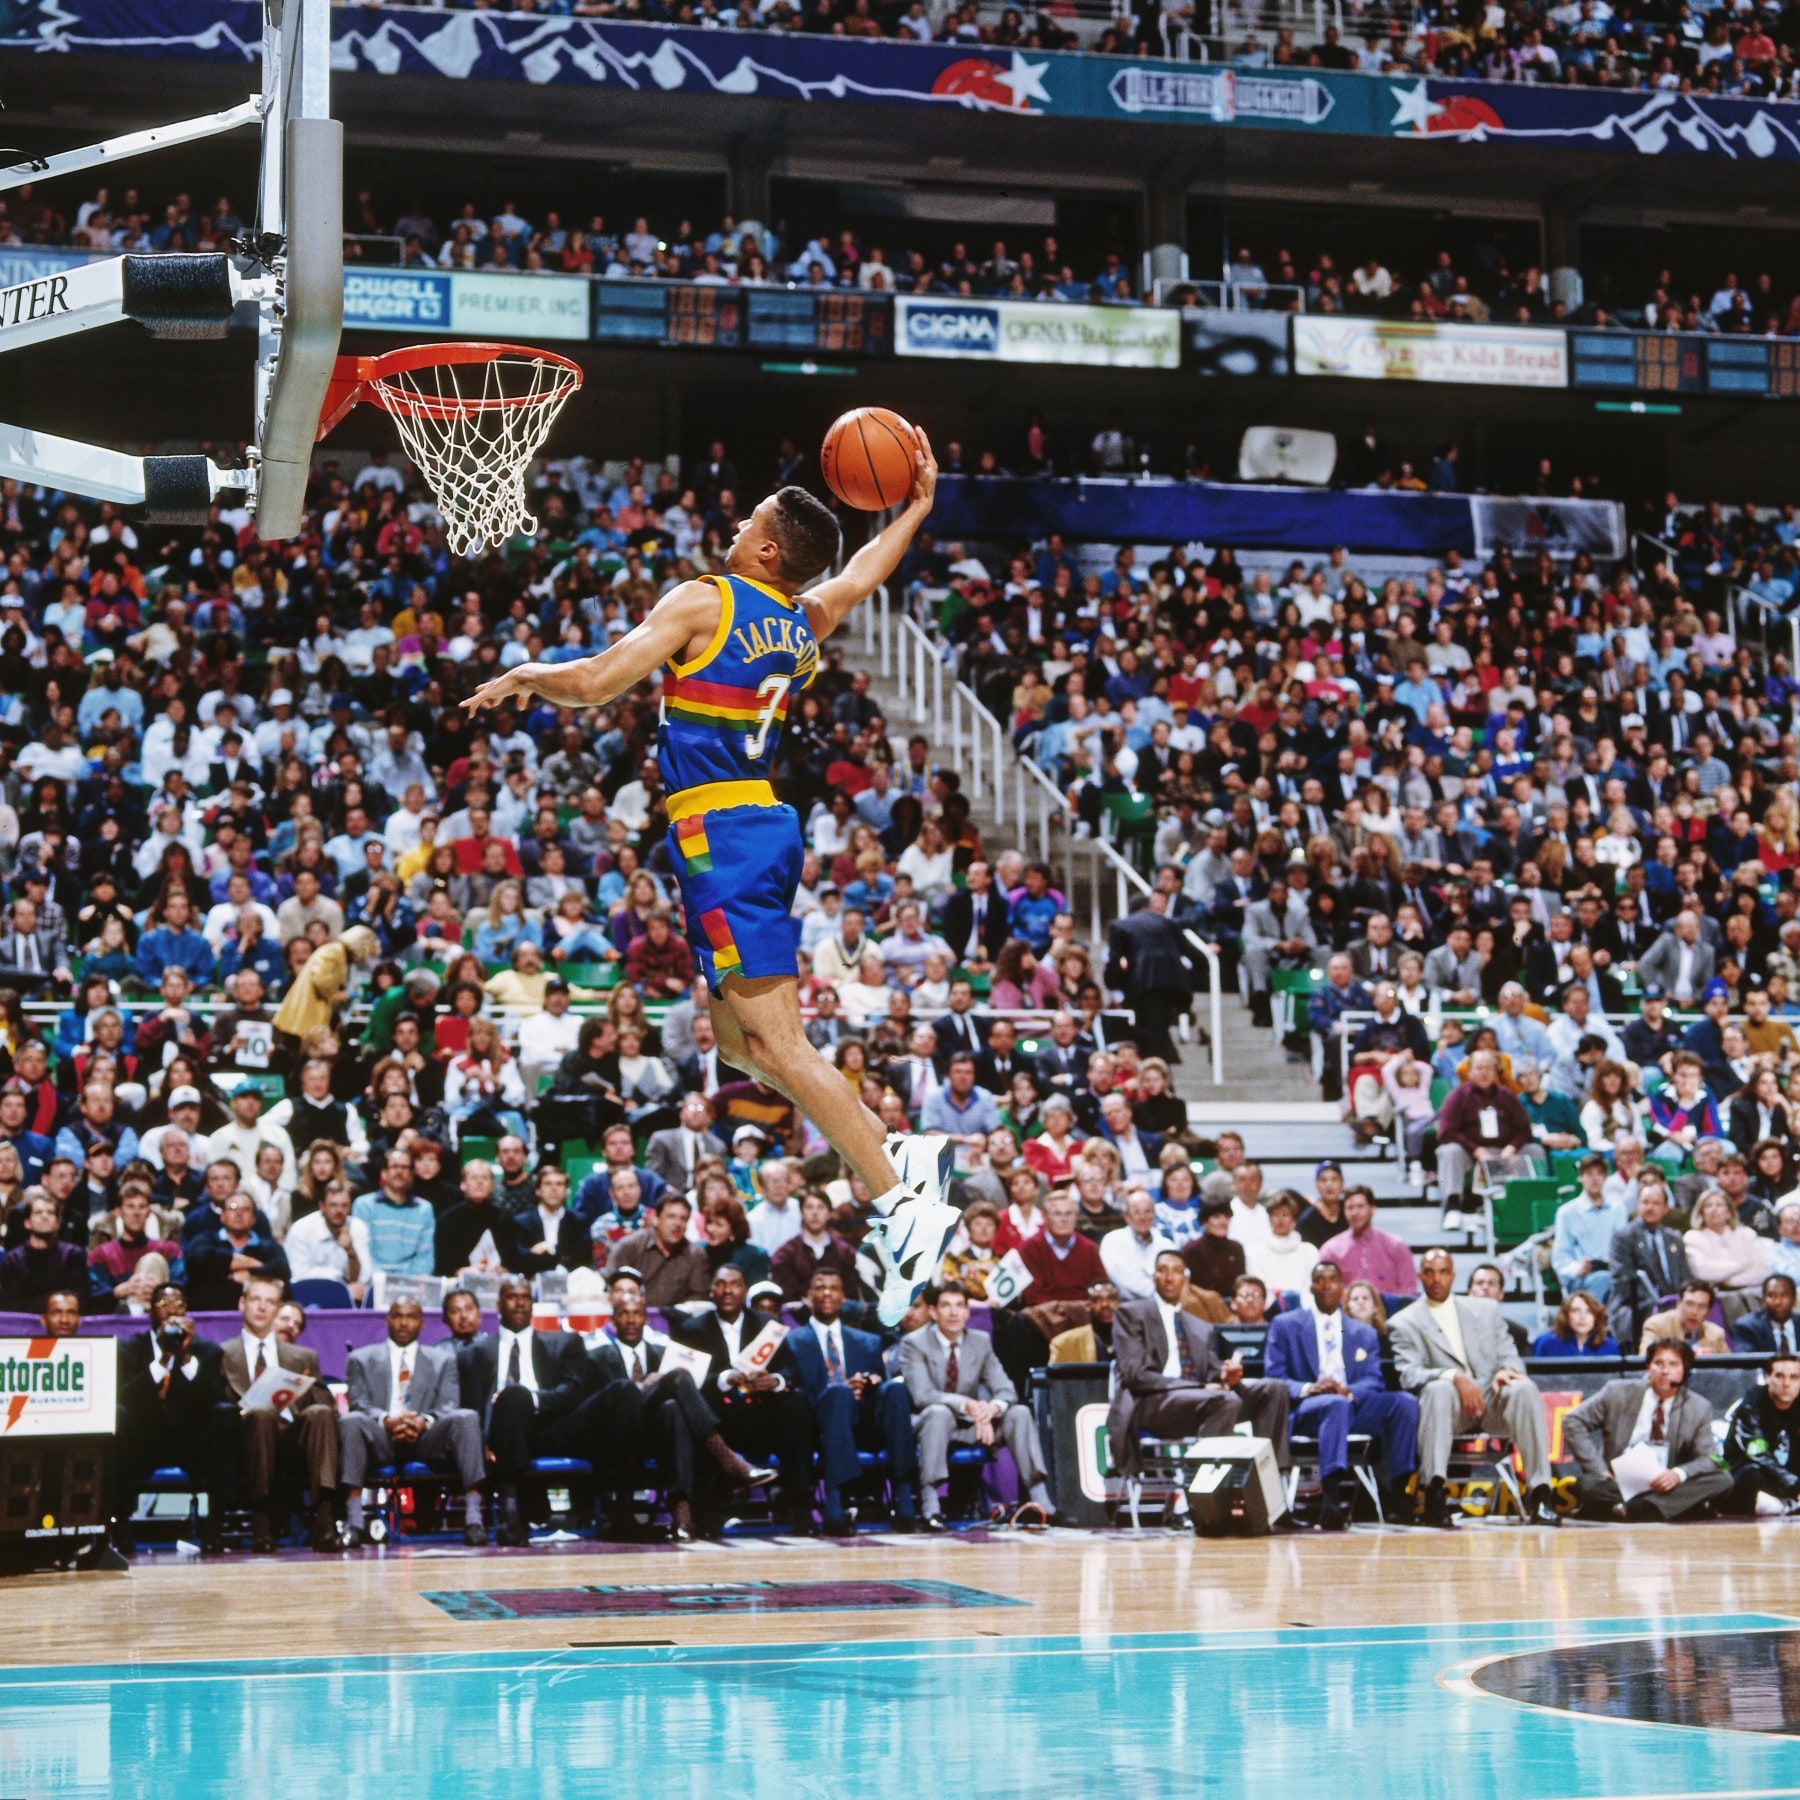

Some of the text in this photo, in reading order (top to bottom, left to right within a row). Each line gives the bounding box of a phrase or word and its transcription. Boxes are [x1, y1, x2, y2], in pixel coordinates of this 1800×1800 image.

[908, 313, 997, 341] CIGNA
[745, 673, 792, 760] 3
[992, 1266, 1015, 1298] 10
